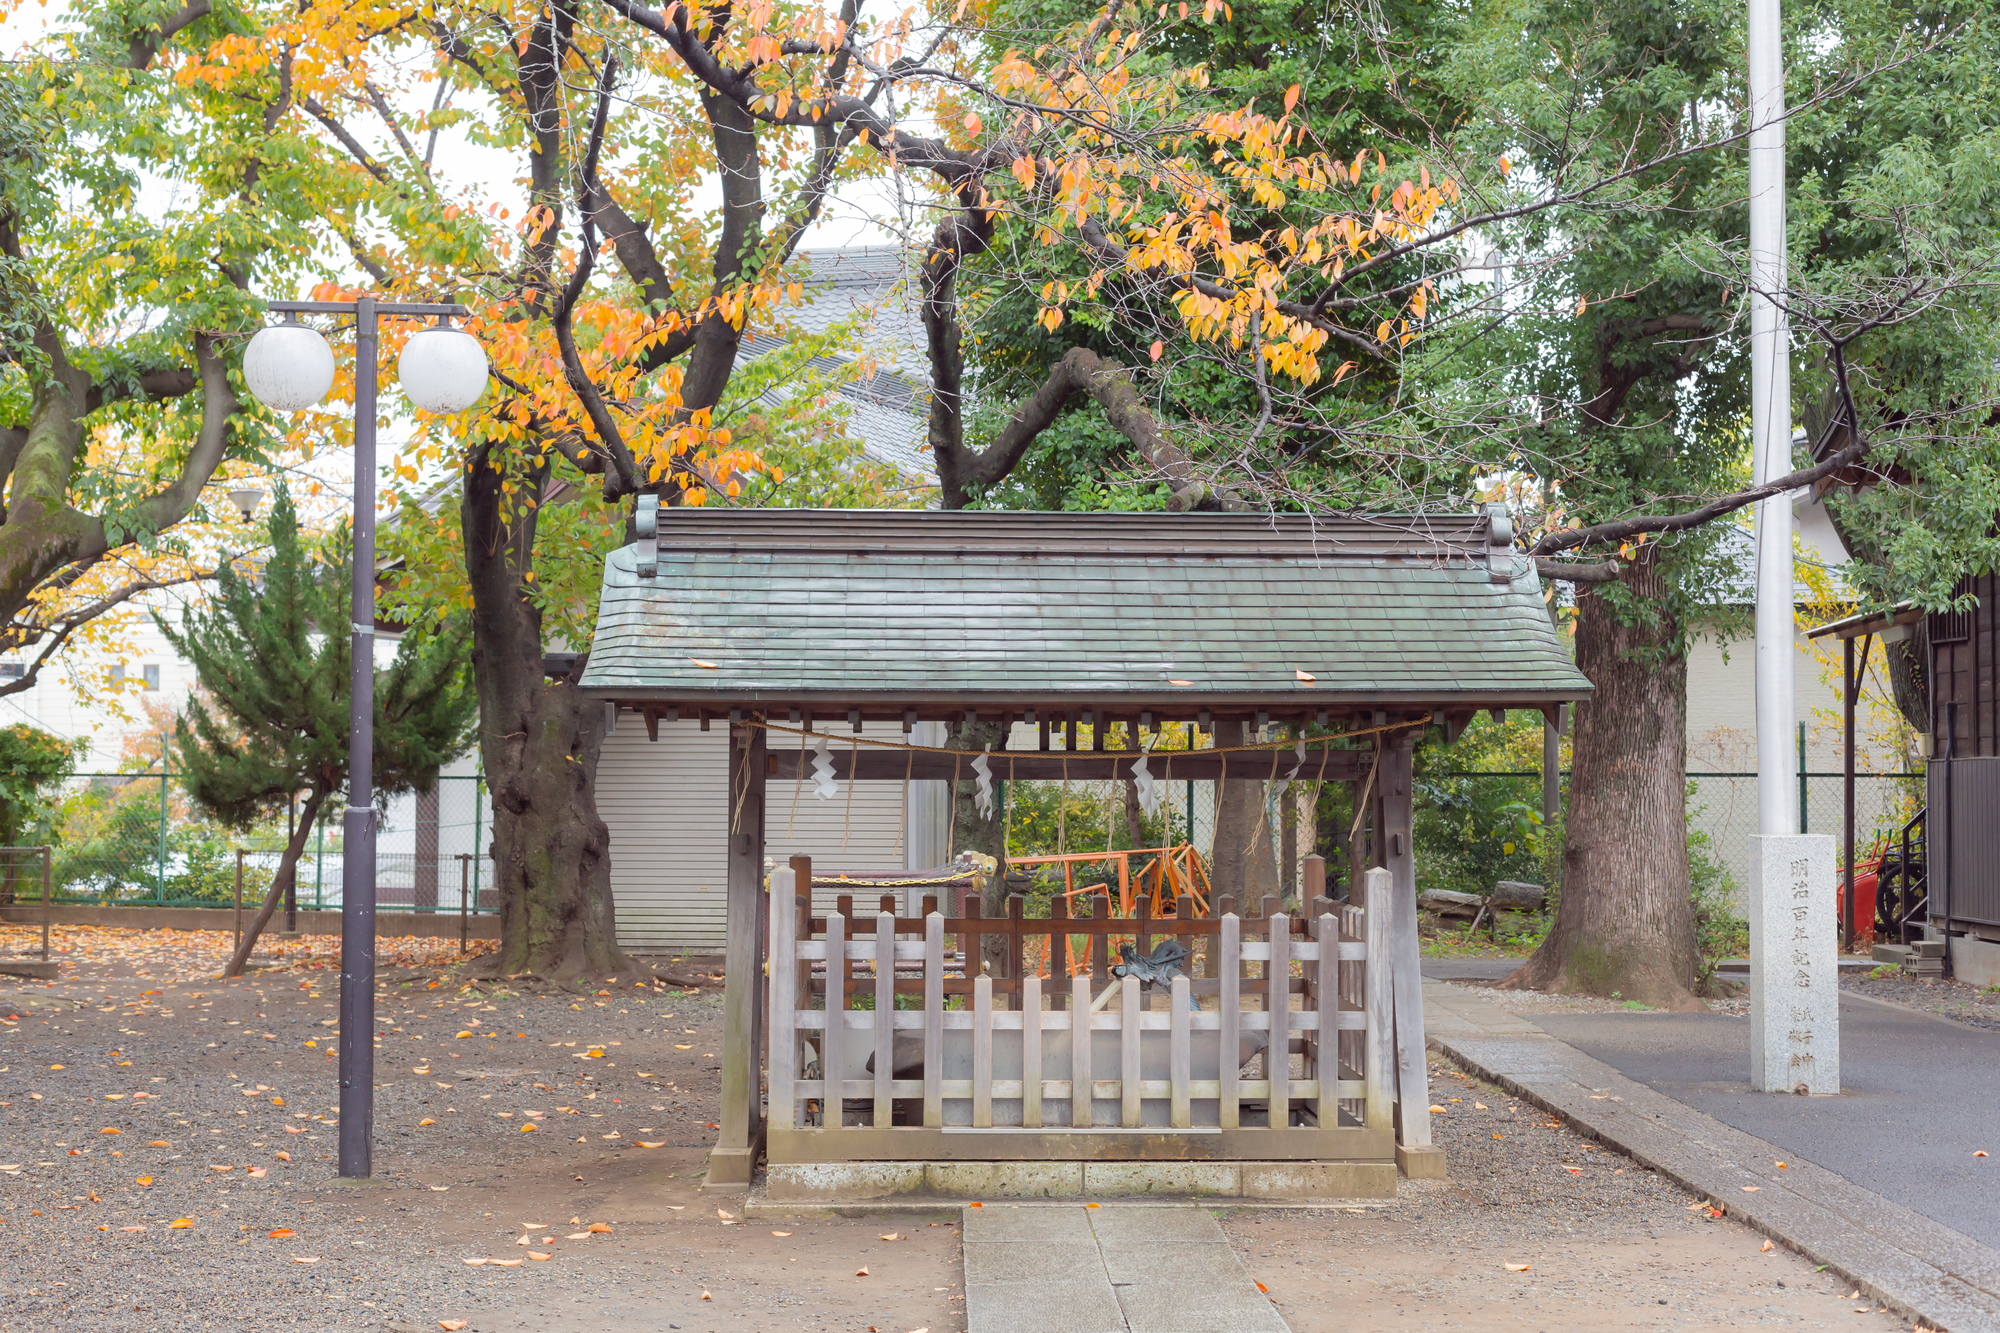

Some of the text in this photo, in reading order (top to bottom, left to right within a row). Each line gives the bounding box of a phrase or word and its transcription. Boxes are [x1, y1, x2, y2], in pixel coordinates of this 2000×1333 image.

[1790, 858, 1811, 988] 明治百年記念
